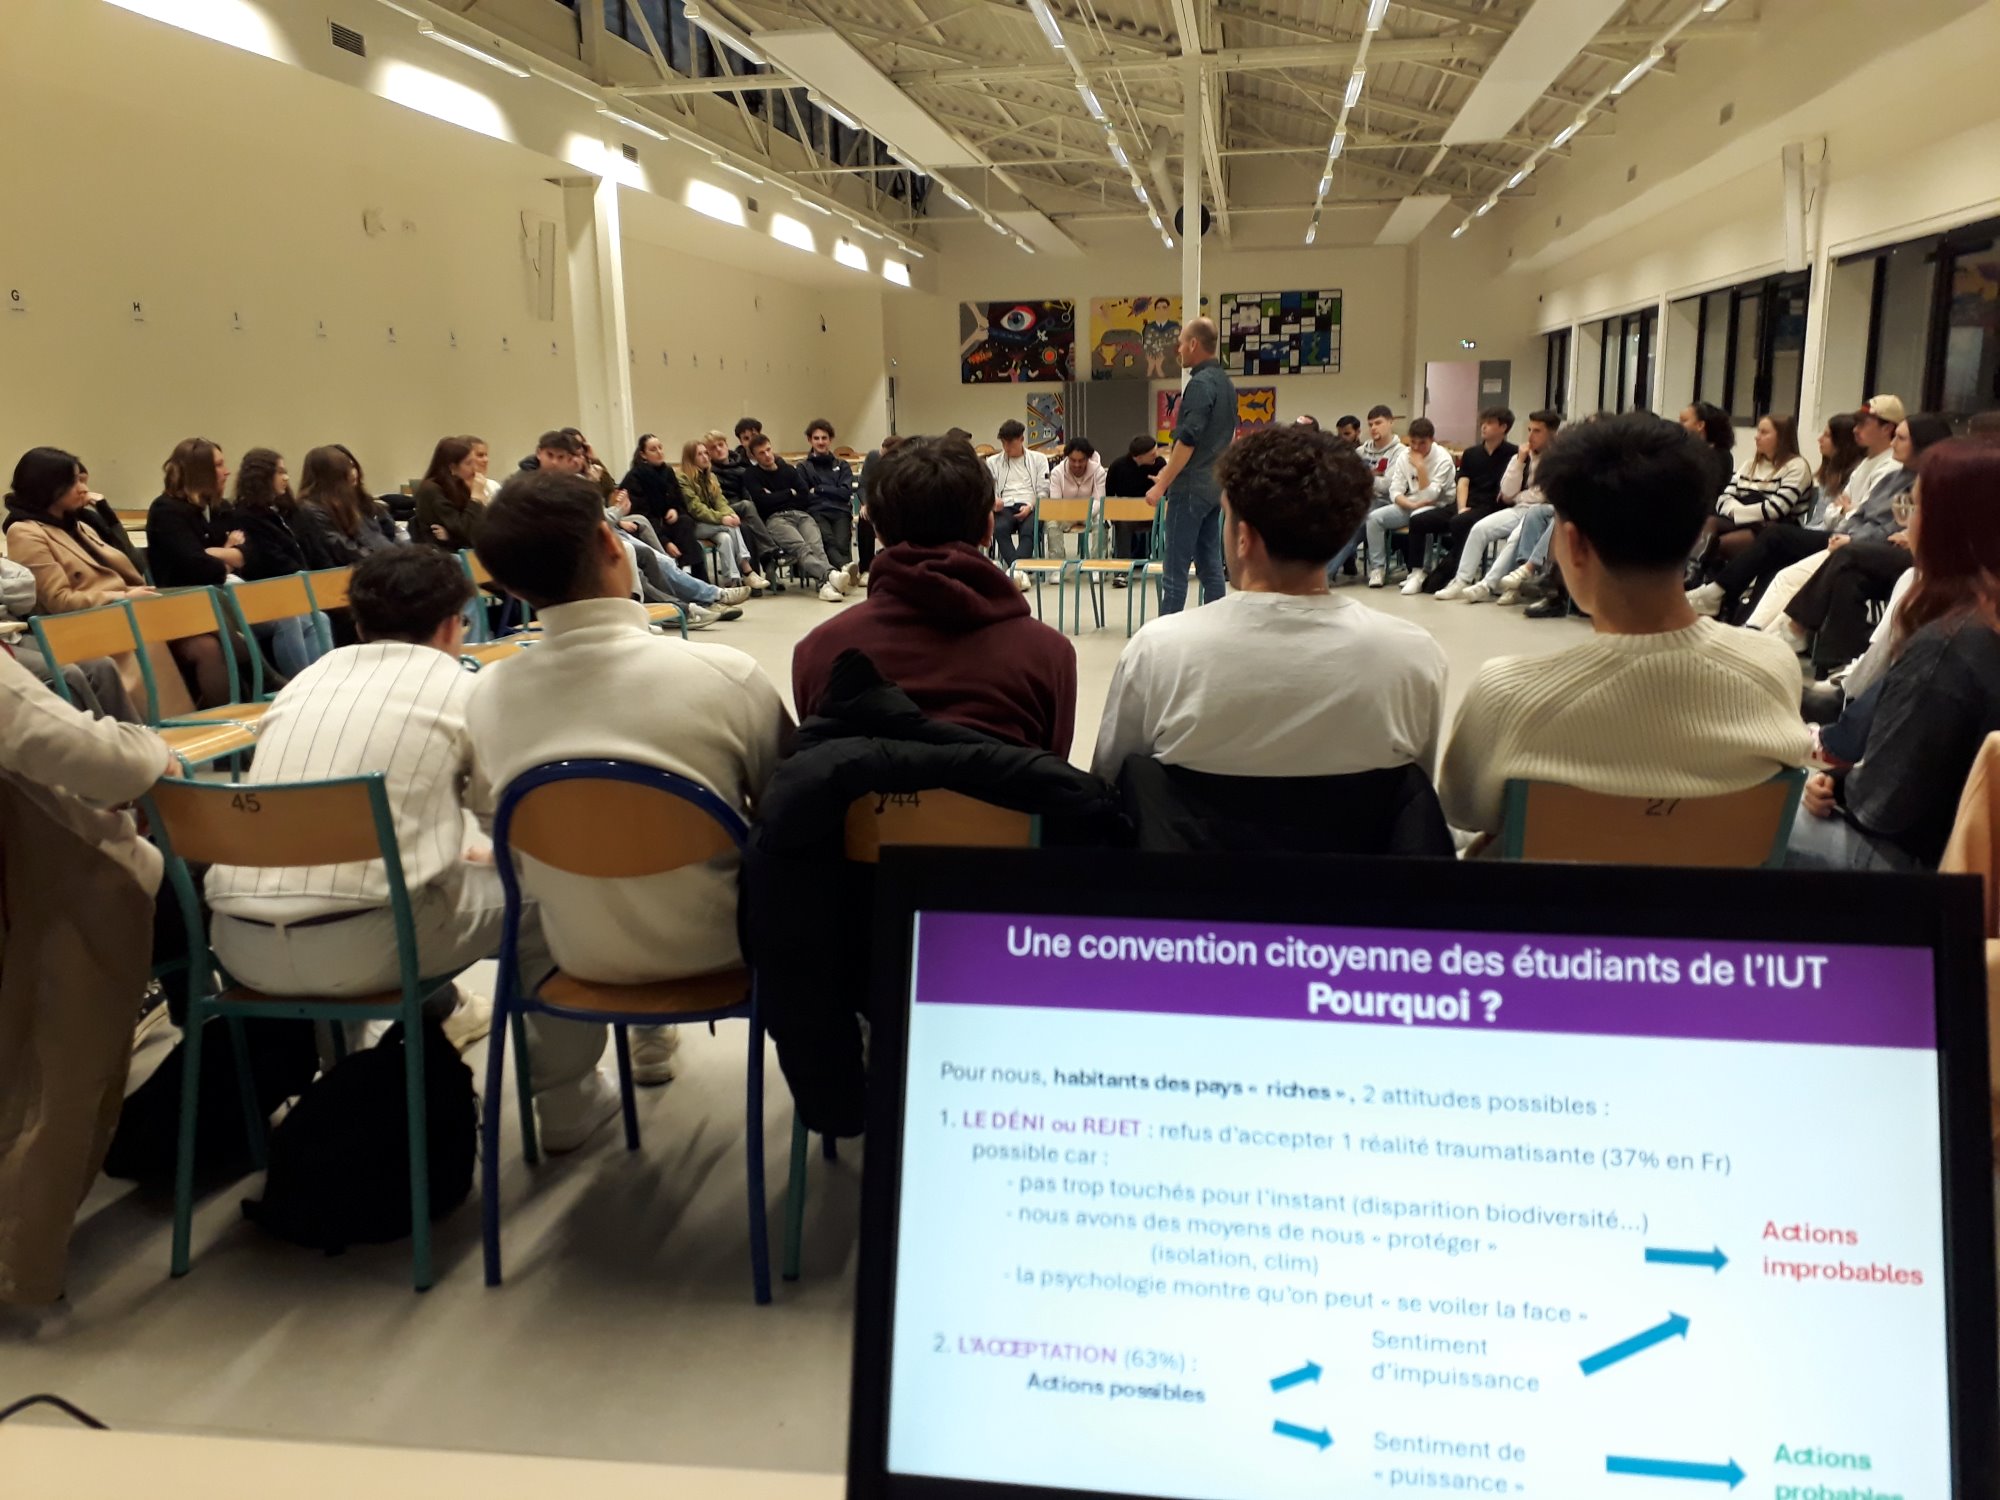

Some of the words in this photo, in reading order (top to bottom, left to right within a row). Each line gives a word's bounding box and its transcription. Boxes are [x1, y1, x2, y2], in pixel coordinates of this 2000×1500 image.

[231, 793, 261, 812] 45
[1007, 926, 1071, 957] Une
[1079, 932, 1257, 965] convention
[1265, 936, 1432, 976] citoyenne
[1440, 943, 1504, 976] des
[1512, 945, 1680, 983] étudiants
[1690, 953, 1734, 986] de
[1307, 982, 1469, 1025] Pourquoi
[1479, 990, 1502, 1023] ?
[941, 1061, 985, 1082] Pour
[992, 1068, 1047, 1086] nous,
[1054, 1069, 1150, 1090] habitants
[1155, 1074, 1190, 1092] des
[1195, 1079, 1243, 1098] pays
[1267, 1077, 1330, 1100] riches
[1363, 1085, 1376, 1104] 2
[1382, 1087, 1482, 1110] attitudes
[1488, 1094, 1597, 1116] possibles
[963, 1111, 985, 1129] LE
[993, 1108, 1044, 1132] DÉNI
[1051, 1118, 1076, 1133] ou
[1083, 1118, 1141, 1137] REJET
[1160, 1123, 1213, 1142] refus
[1344, 1133, 1351, 1151] 1
[1360, 1134, 1429, 1157] réalité
[1435, 1139, 1595, 1165] traumatisante
[1602, 1147, 1659, 1170] (37%
[1667, 1154, 1694, 1170] en
[1702, 1153, 1731, 1176] Fr)
[972, 1142, 1058, 1163] possible
[1064, 1151, 1096, 1165] car
[1018, 1176, 1057, 1196] pas
[1063, 1178, 1104, 1198] trop
[1110, 1180, 1195, 1201] touchés
[1202, 1188, 1250, 1206] pour
[1353, 1196, 1479, 1220] (disparition
[1018, 1207, 1069, 1224] nous
[1075, 1211, 1137, 1229] avons
[1144, 1213, 1180, 1233] des
[1187, 1218, 1271, 1241] moyens
[1278, 1222, 1304, 1242] de
[1312, 1227, 1365, 1245] nous
[1388, 1232, 1481, 1257] protéger
[1762, 1220, 1859, 1245] Actions
[1151, 1242, 1257, 1271] (isolation,
[1264, 1252, 1319, 1277] clim)
[1763, 1256, 1924, 1286] improbables
[1016, 1266, 1034, 1283] la
[1040, 1271, 1167, 1297] psychologie
[1173, 1281, 1250, 1300] montre
[1325, 1292, 1373, 1310] peut
[1398, 1296, 1421, 1312] se
[1429, 1298, 1489, 1318] voiler
[1497, 1301, 1516, 1320] la
[1522, 1302, 1571, 1322] face
[1371, 1330, 1488, 1356] Sentiment
[1124, 1349, 1186, 1373] (63%)
[1026, 1372, 1105, 1395] Actions
[1109, 1381, 1206, 1404] possibles
[1374, 1432, 1490, 1460] Sentiment
[1497, 1442, 1526, 1463] de
[1774, 1443, 1872, 1471] Actions
[1390, 1467, 1508, 1494] puissance
